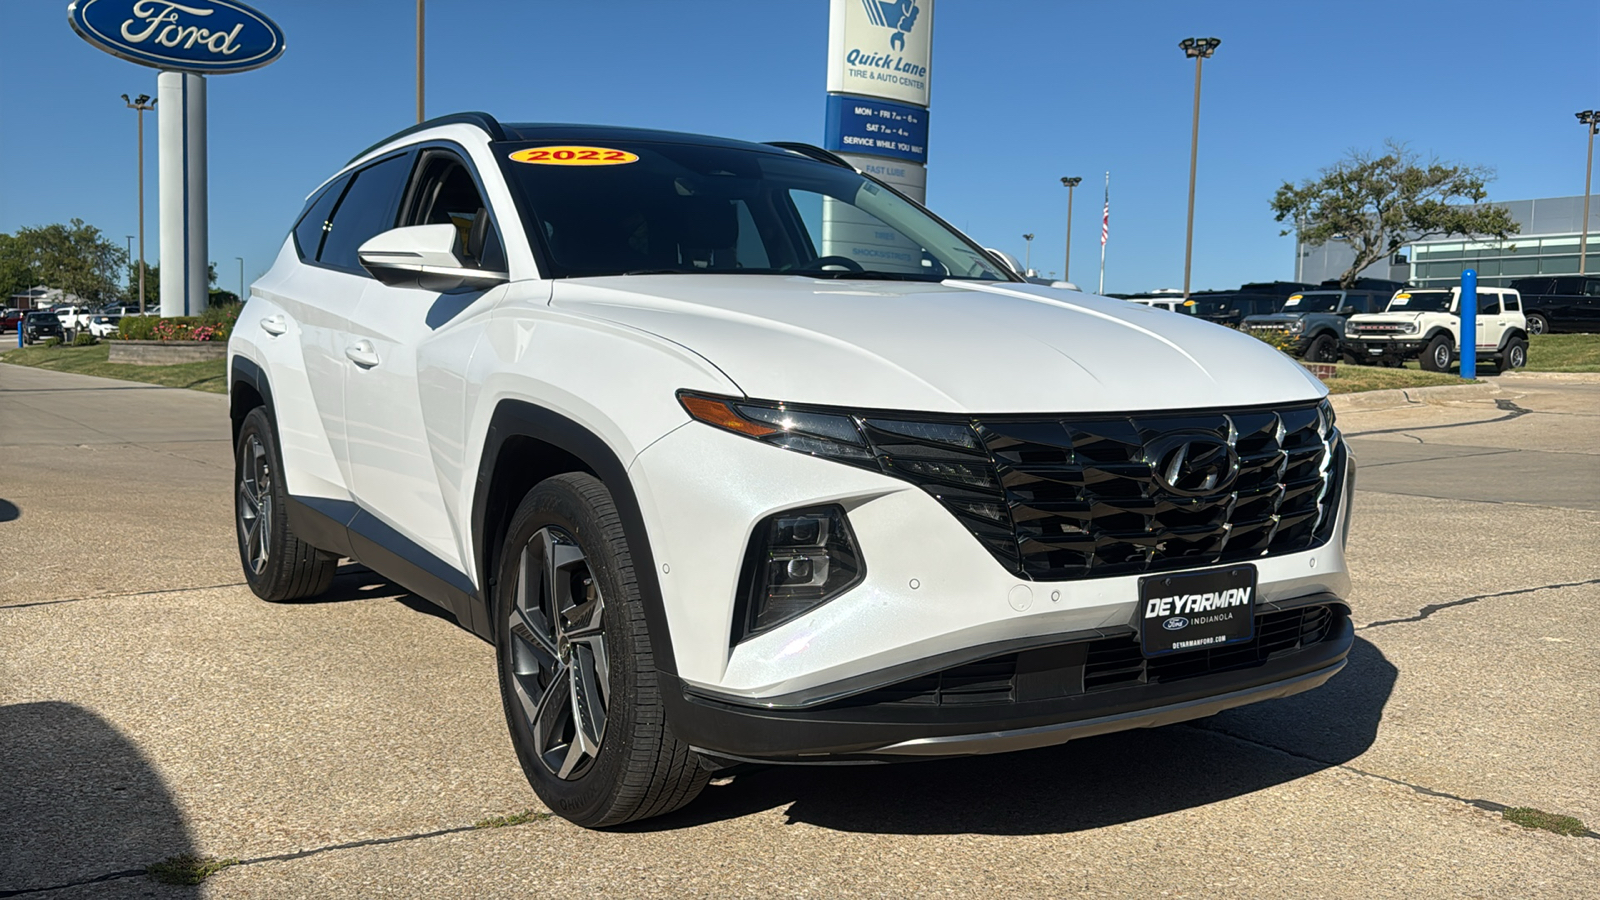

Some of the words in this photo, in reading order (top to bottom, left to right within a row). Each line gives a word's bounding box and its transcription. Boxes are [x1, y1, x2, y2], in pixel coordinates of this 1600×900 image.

[121, 0, 244, 55] Ford
[846, 48, 894, 70] Quick
[894, 57, 926, 77] Lane
[849, 69, 868, 78] TIRE
[869, 72, 875, 80] &
[877, 73, 898, 83] AUTO
[899, 76, 925, 90] CENTER
[854, 106, 872, 116] MON
[879, 110, 890, 119] FRI
[866, 123, 879, 132] SAT
[843, 136, 875, 147] SERVICE
[876, 140, 896, 149] WHILE
[897, 143, 910, 152] YOU
[526, 150, 627, 162] 2022
[866, 165, 885, 175] FAST
[887, 167, 906, 177] LUBE
[1144, 586, 1252, 619] DEYARMAN
[1190, 612, 1233, 626] INDIANOLA
[1172, 635, 1227, 649] DEYARMANFORD.COM
